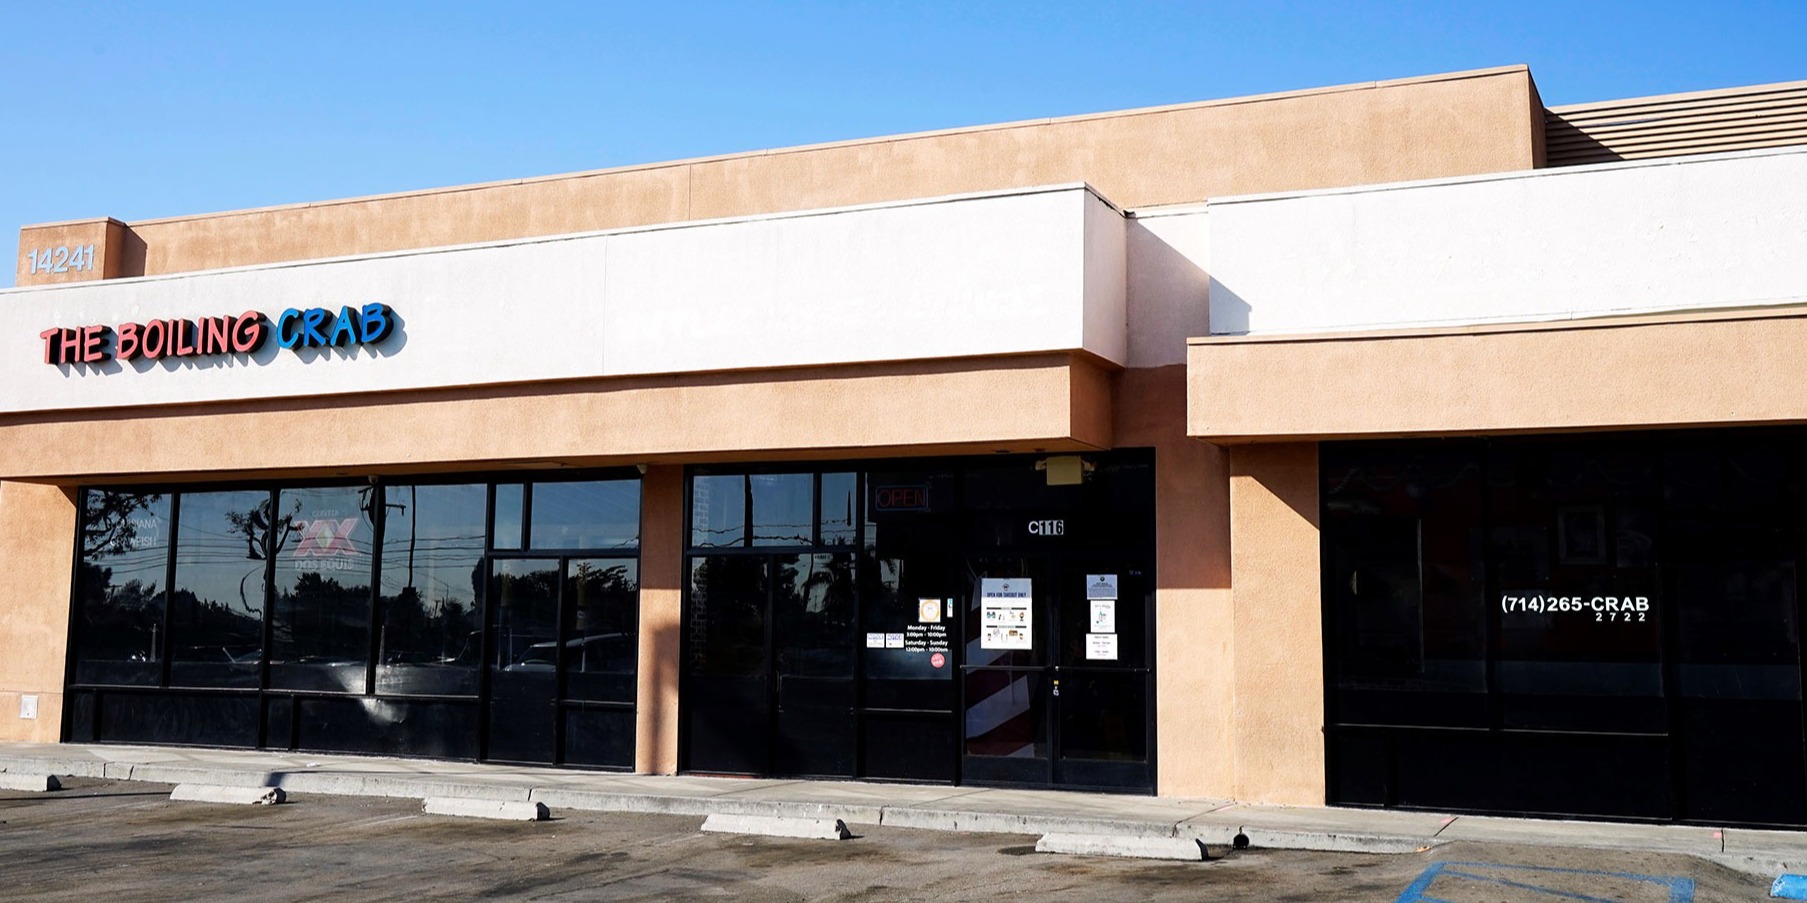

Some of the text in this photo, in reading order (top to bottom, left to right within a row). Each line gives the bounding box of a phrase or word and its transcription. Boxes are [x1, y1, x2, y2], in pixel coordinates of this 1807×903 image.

[28, 244, 95, 275] 14241
[39, 302, 391, 364] THE BOILING CRAB
[877, 488, 926, 507] OPEN
[1028, 519, 1064, 536] C116
